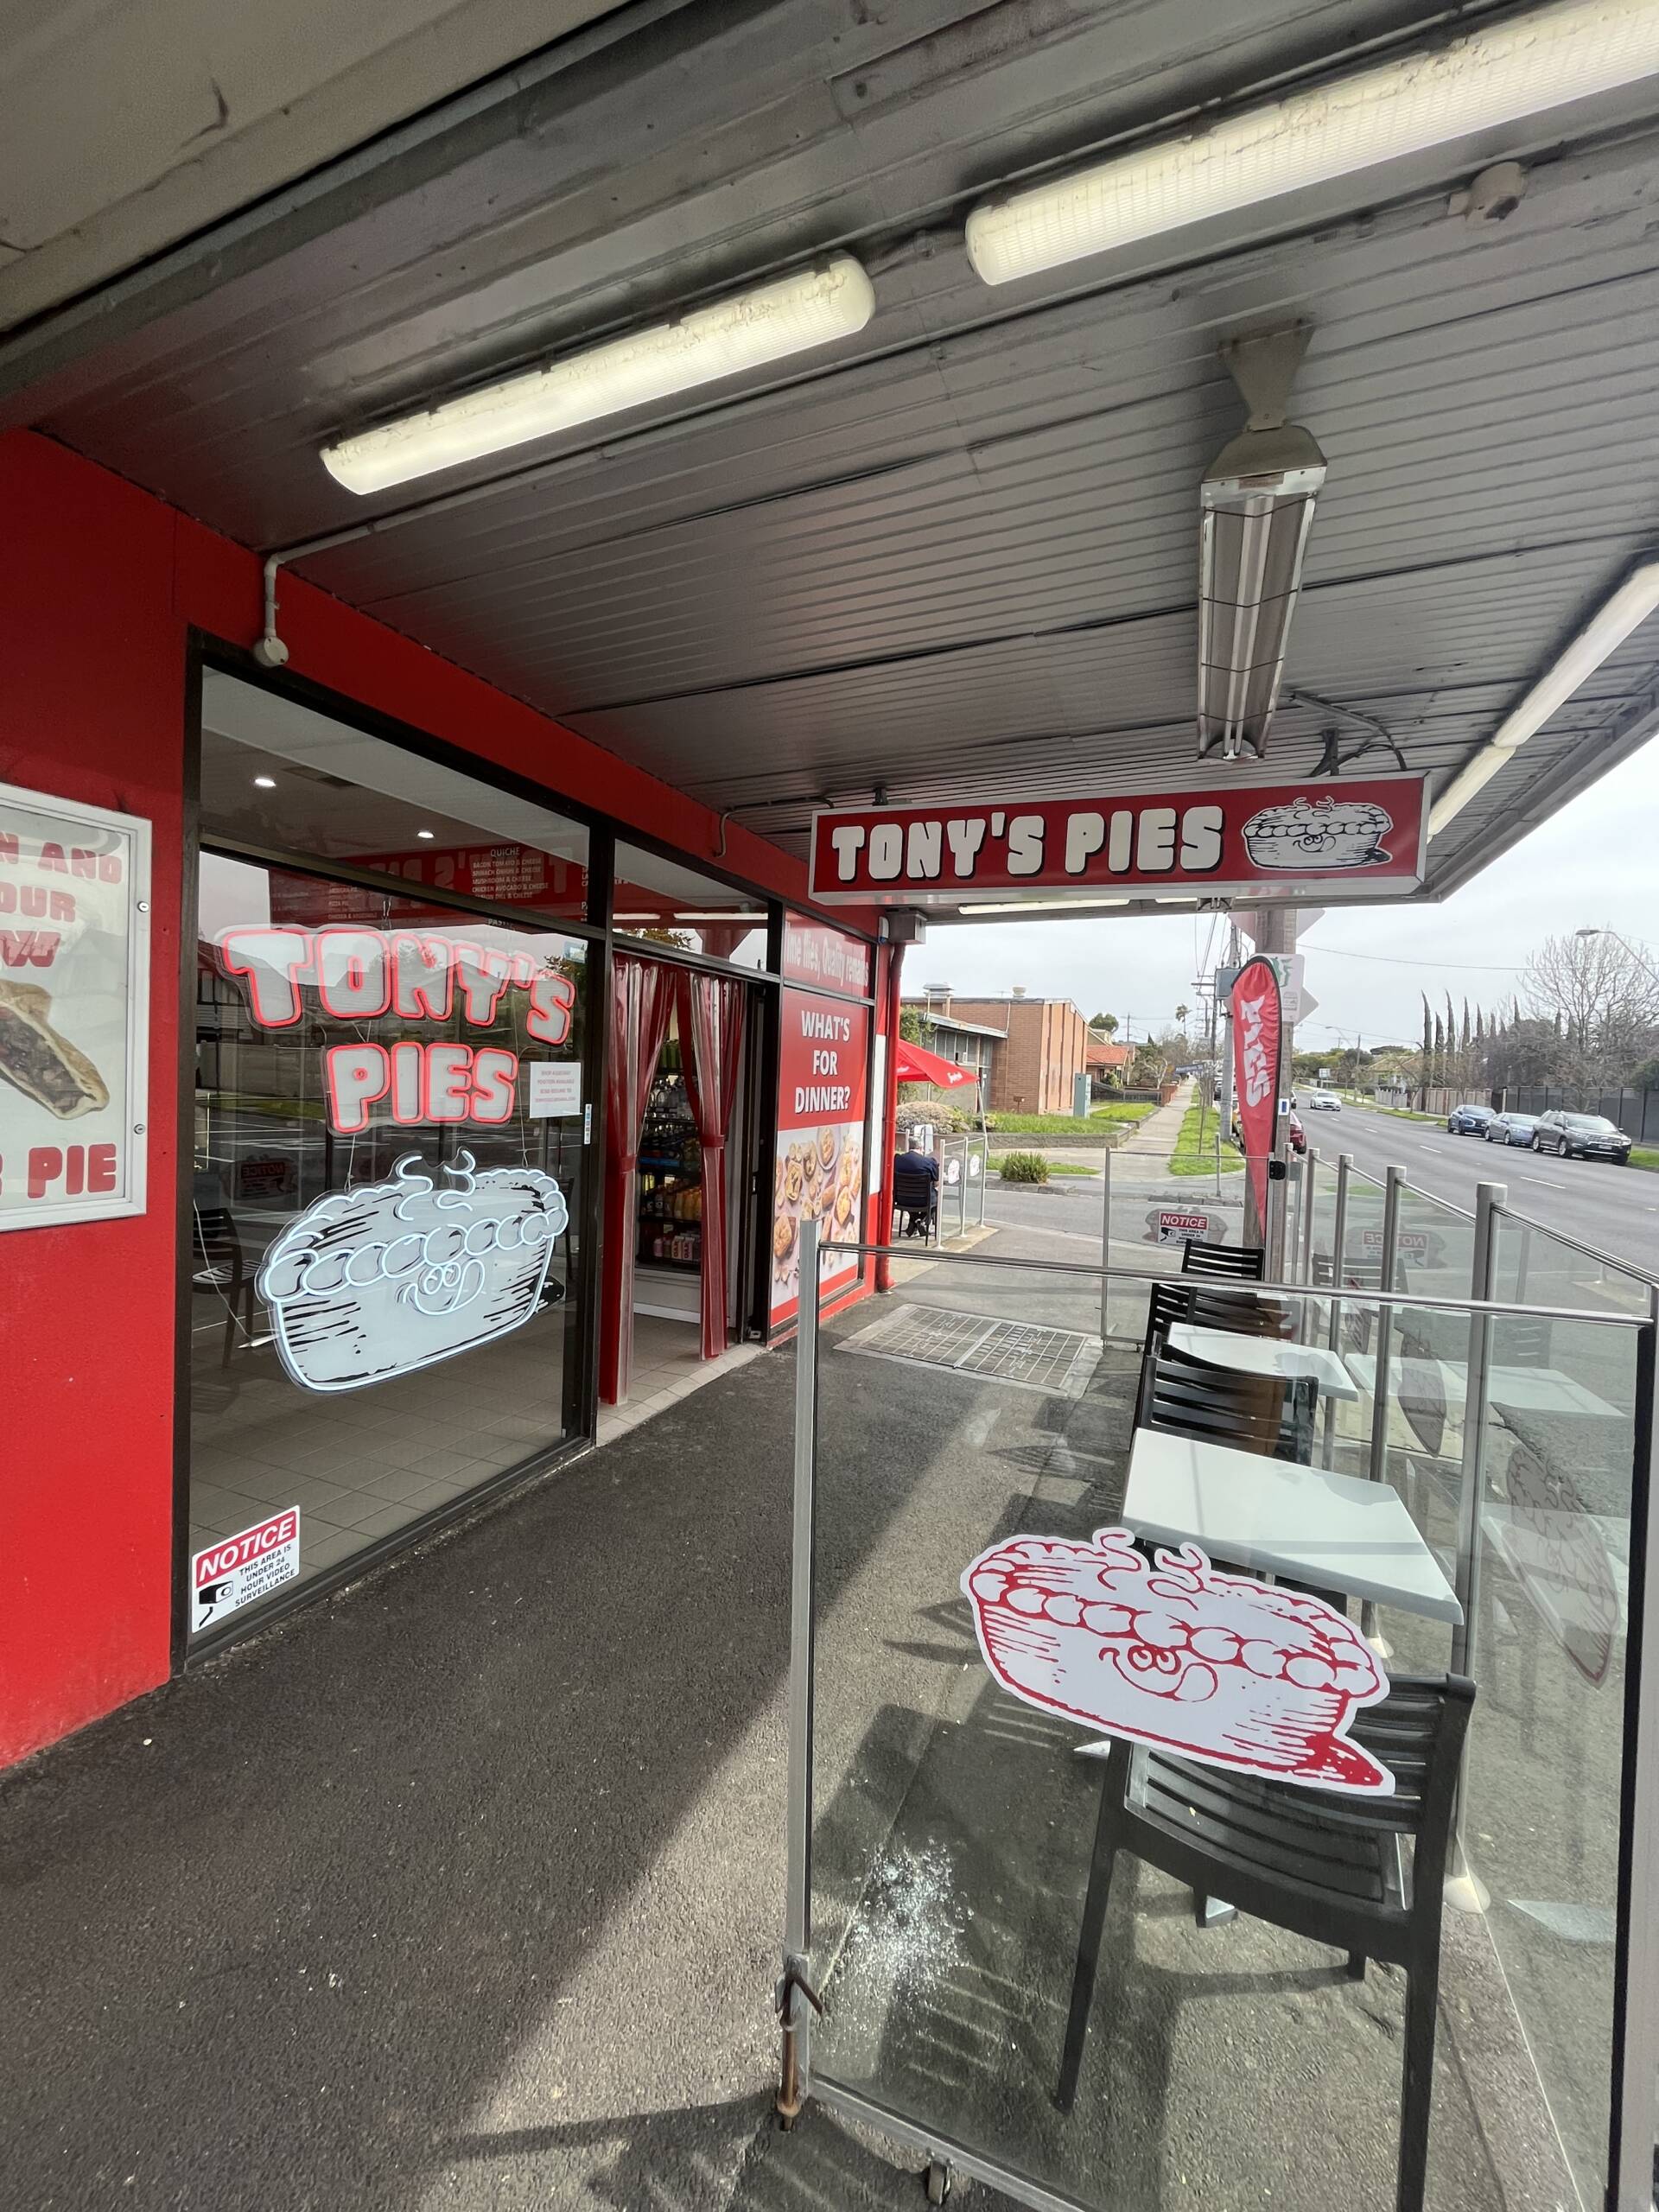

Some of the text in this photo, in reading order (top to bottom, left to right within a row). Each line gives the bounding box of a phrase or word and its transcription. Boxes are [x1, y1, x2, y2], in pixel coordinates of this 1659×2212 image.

[490, 848, 520, 857] QUICHE
[830, 805, 1224, 881] TONY'S PIES
[38, 842, 122, 884] AND
[221, 926, 576, 1046] TONY'S
[801, 1010, 850, 1042] WHAT'S
[812, 1050, 838, 1076] FOR
[1240, 995, 1271, 1107] PIES
[326, 1041, 518, 1134] PIES
[795, 1085, 851, 1115] DINNER?
[29, 1143, 116, 1199] PIE
[1161, 1215, 1206, 1228] NOTICE
[199, 1516, 295, 1582] NOTICE
[239, 1544, 291, 1576] THIS AREA IS
[241, 1562, 290, 1595] HOUR VIDEO
[246, 1556, 285, 1582] UNDER 24
[235, 1568, 296, 1607] SURVEILLANCE
